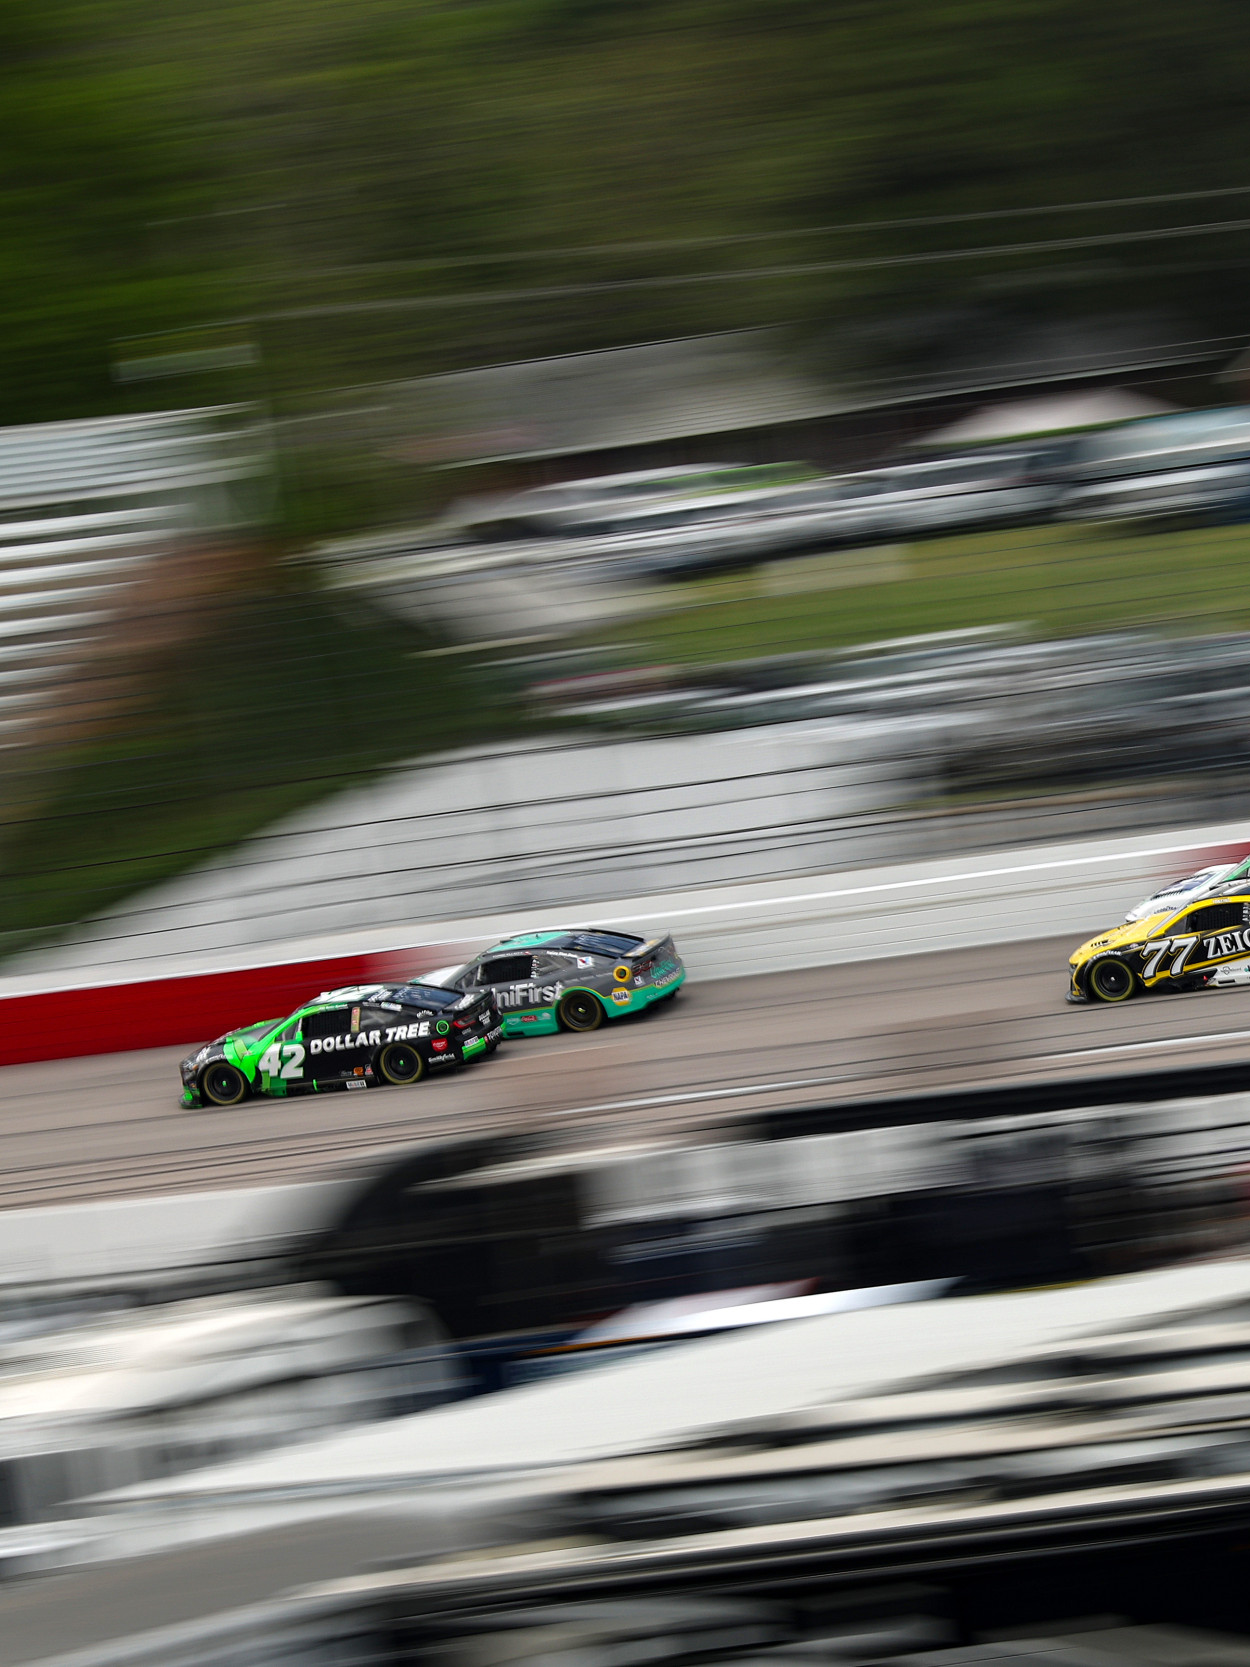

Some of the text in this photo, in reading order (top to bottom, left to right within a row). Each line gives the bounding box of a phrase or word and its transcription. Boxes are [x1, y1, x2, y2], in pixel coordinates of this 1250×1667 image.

[1141, 936, 1198, 979] 77
[613, 991, 629, 1001] NAPA
[310, 1021, 430, 1055] DOLLAR TREE
[259, 1042, 305, 1079] 42
